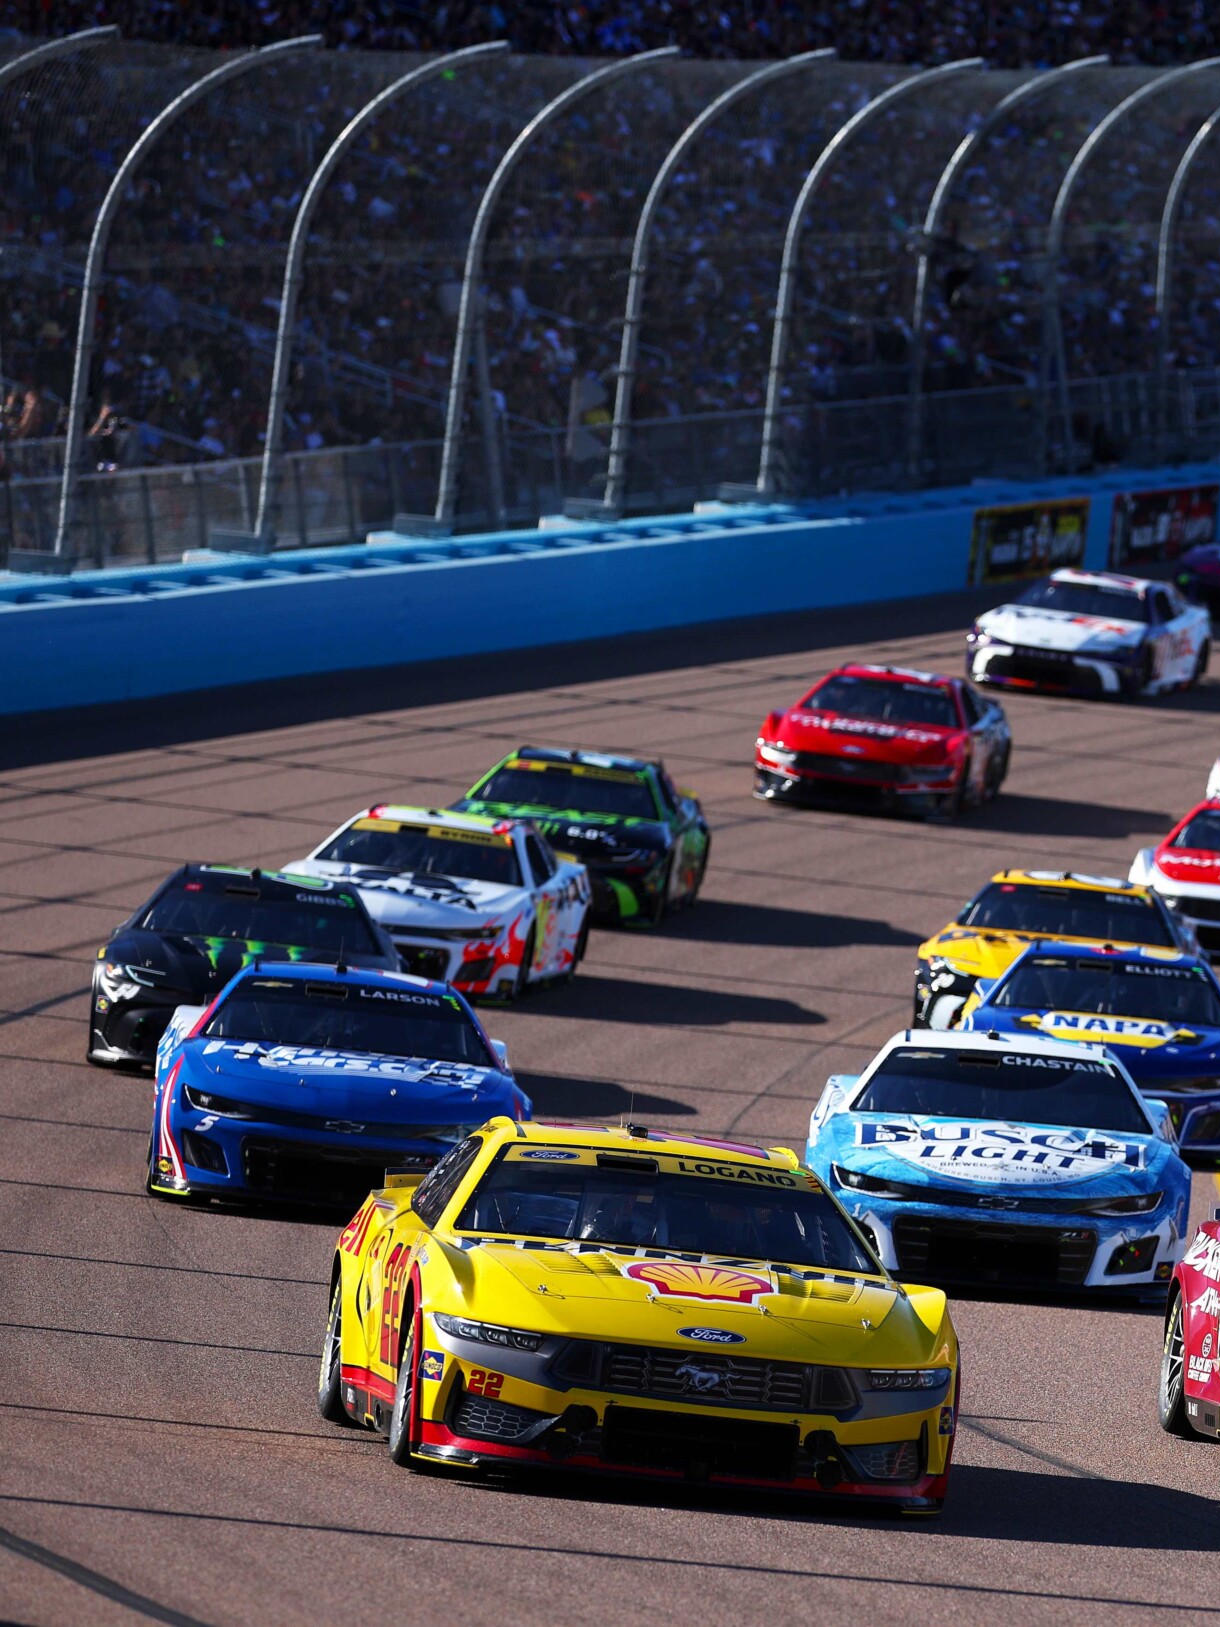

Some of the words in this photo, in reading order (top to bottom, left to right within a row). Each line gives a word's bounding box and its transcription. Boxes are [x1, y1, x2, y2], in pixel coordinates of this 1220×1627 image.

[1125, 965, 1193, 979] ELLIOTT
[360, 989, 440, 1008] LARSON
[1053, 1015, 1167, 1037] NAPA
[1002, 1055, 1107, 1074] CHASTAIN
[194, 1115, 221, 1132] 5
[524, 1151, 570, 1161] Ford
[855, 1122, 1148, 1171] BUSCH
[919, 1145, 1086, 1169] LIGHT
[678, 1161, 797, 1188] LOGANO
[852, 1202, 862, 1218] 1
[690, 1328, 732, 1342] Ford
[421, 1361, 443, 1372] SUNOCO
[467, 1369, 504, 1398] 22
